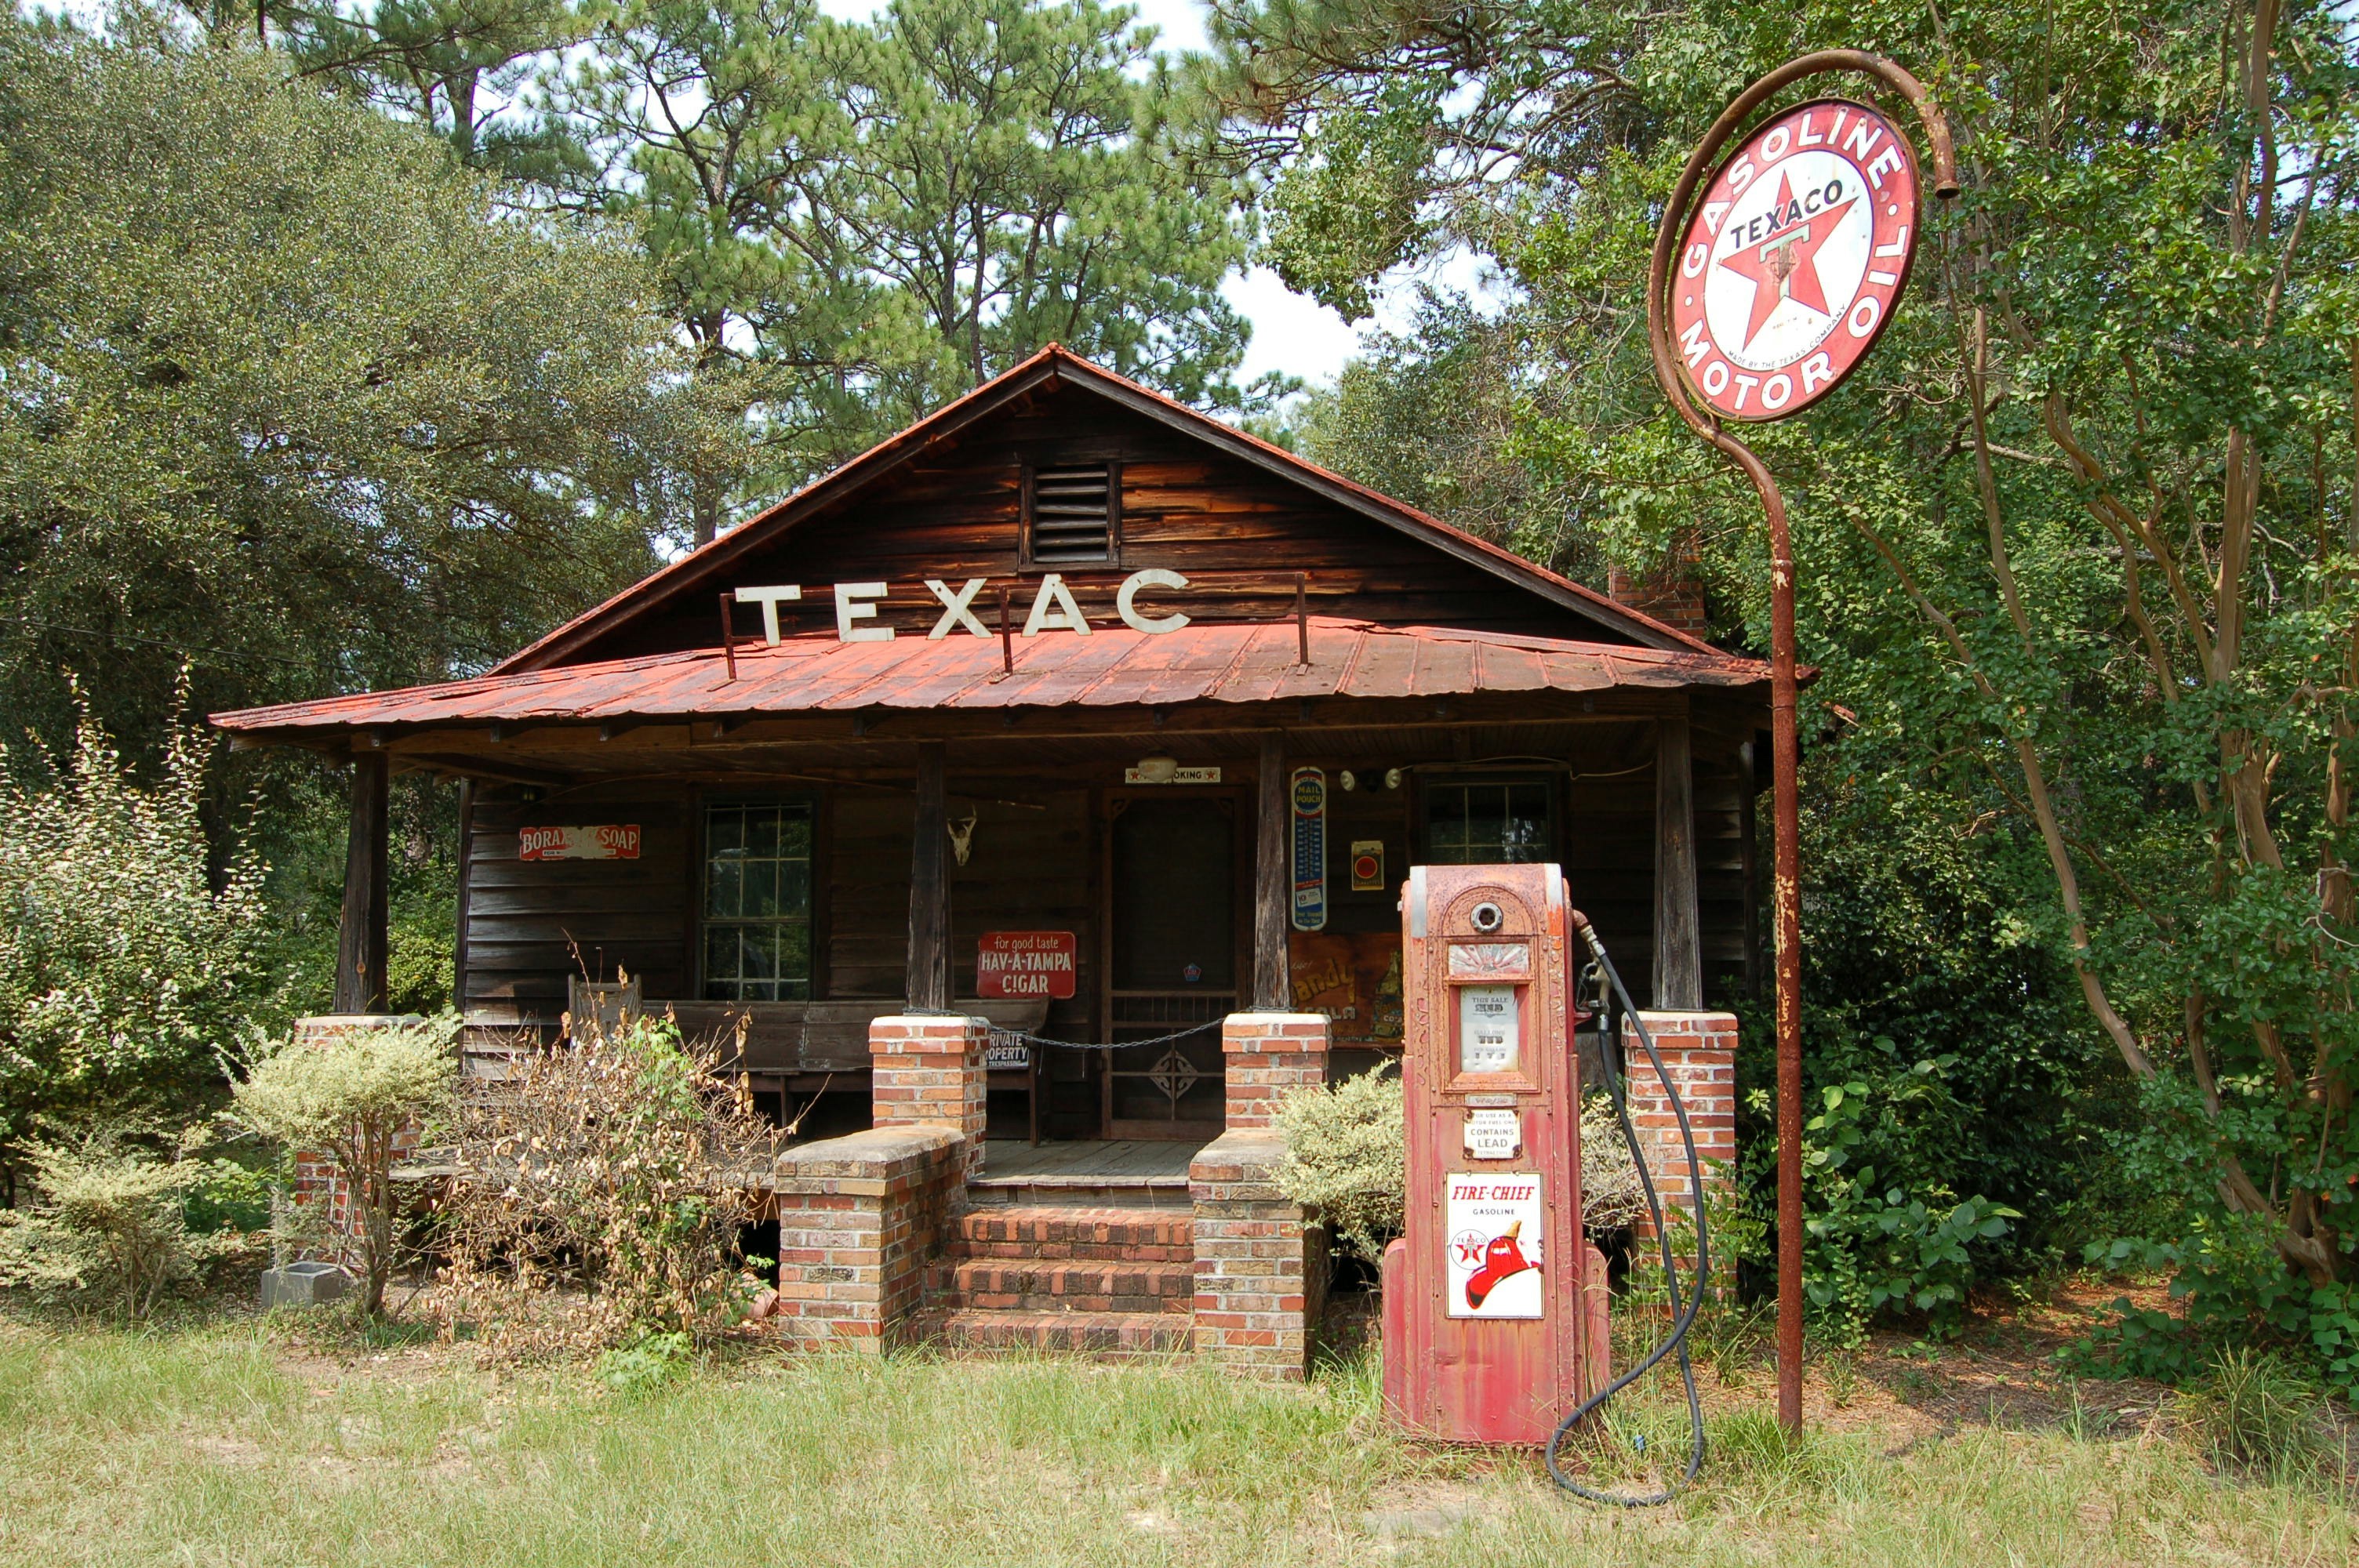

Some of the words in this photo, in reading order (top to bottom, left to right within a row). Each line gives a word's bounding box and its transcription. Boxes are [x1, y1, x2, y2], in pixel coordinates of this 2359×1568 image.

[1682, 107, 1903, 279] GASOLINE
[1730, 180, 1843, 249] TEXACO
[1680, 318, 1834, 411] MOTOR
[1847, 224, 1908, 339] OIL
[1728, 350, 1746, 365] MADE
[1779, 349, 1806, 365] TEXAS
[1809, 303, 1845, 348] COMPANY
[735, 568, 1191, 647] TEXAC
[1296, 795, 1321, 804] POUCH
[601, 829, 637, 851] SOAP
[994, 936, 1009, 950] for
[1012, 936, 1034, 953] good
[1037, 936, 1059, 949] taste
[982, 952, 1072, 971] HAV-A-TAMPA
[1001, 975, 1049, 993] CIGAR
[1478, 1138, 1508, 1148] LEAD
[1452, 1185, 1535, 1200] FIRE-CHIEF
